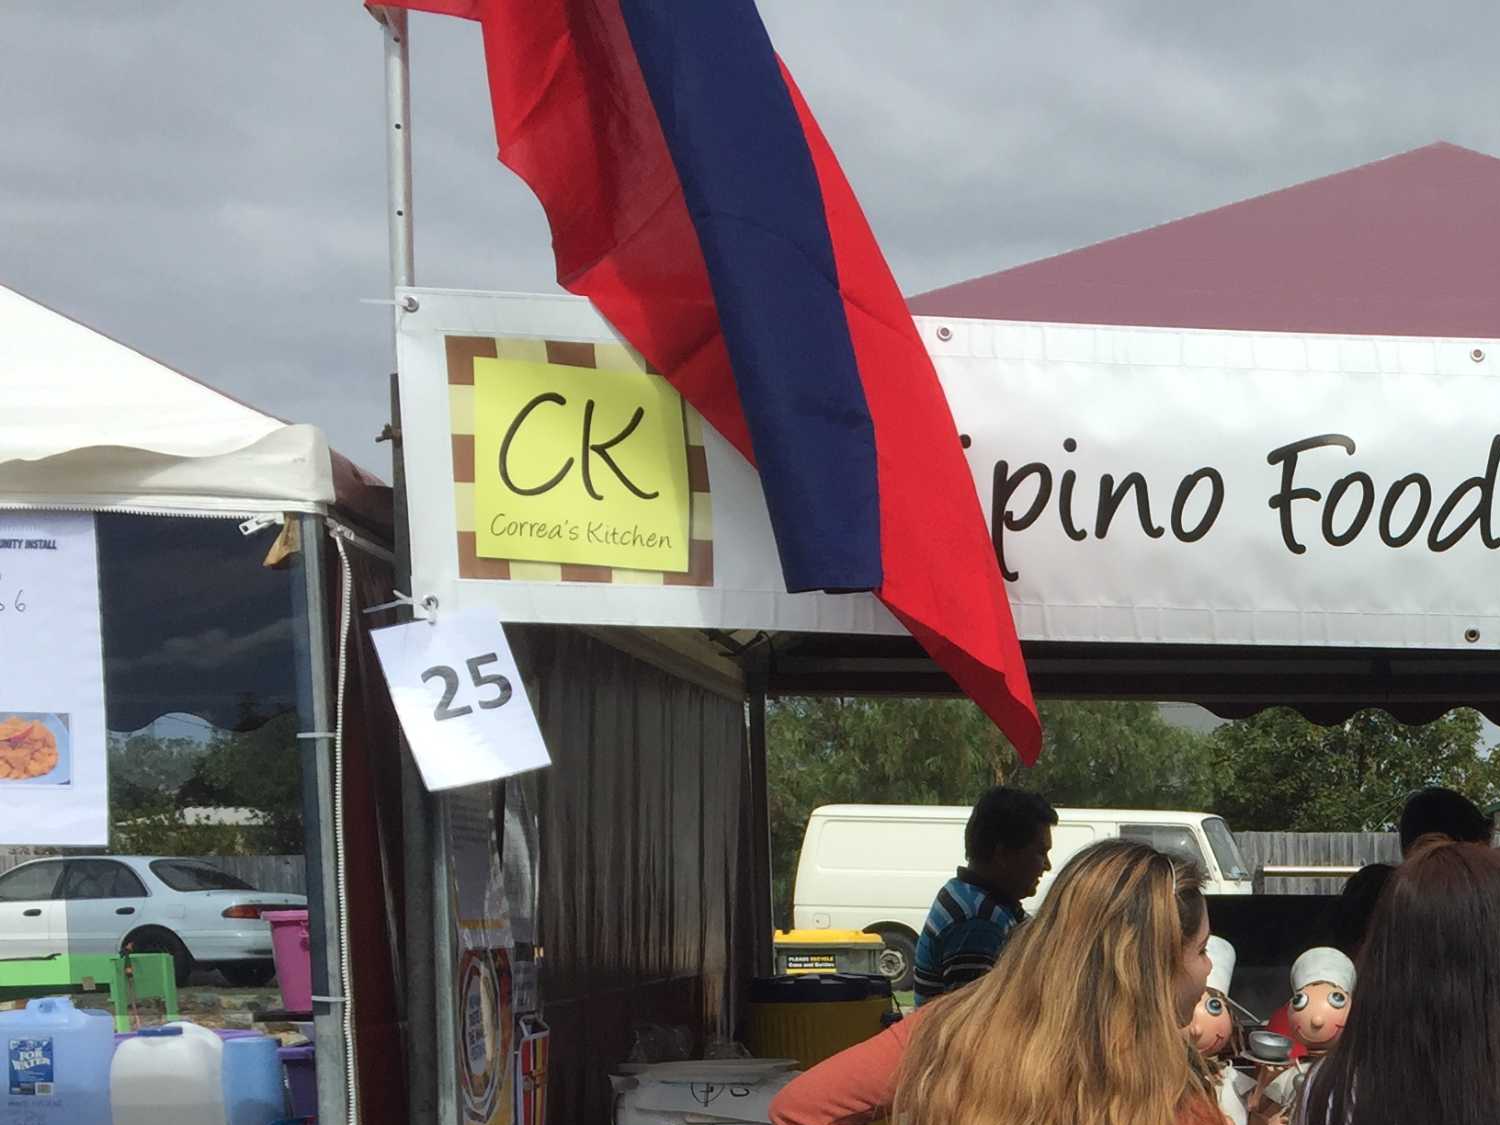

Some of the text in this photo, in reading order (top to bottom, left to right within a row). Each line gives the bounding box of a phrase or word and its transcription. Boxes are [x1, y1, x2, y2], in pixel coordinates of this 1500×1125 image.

[498, 391, 660, 501] CK
[490, 513, 672, 549] Correa's Kitchen
[421, 652, 512, 721] 25
